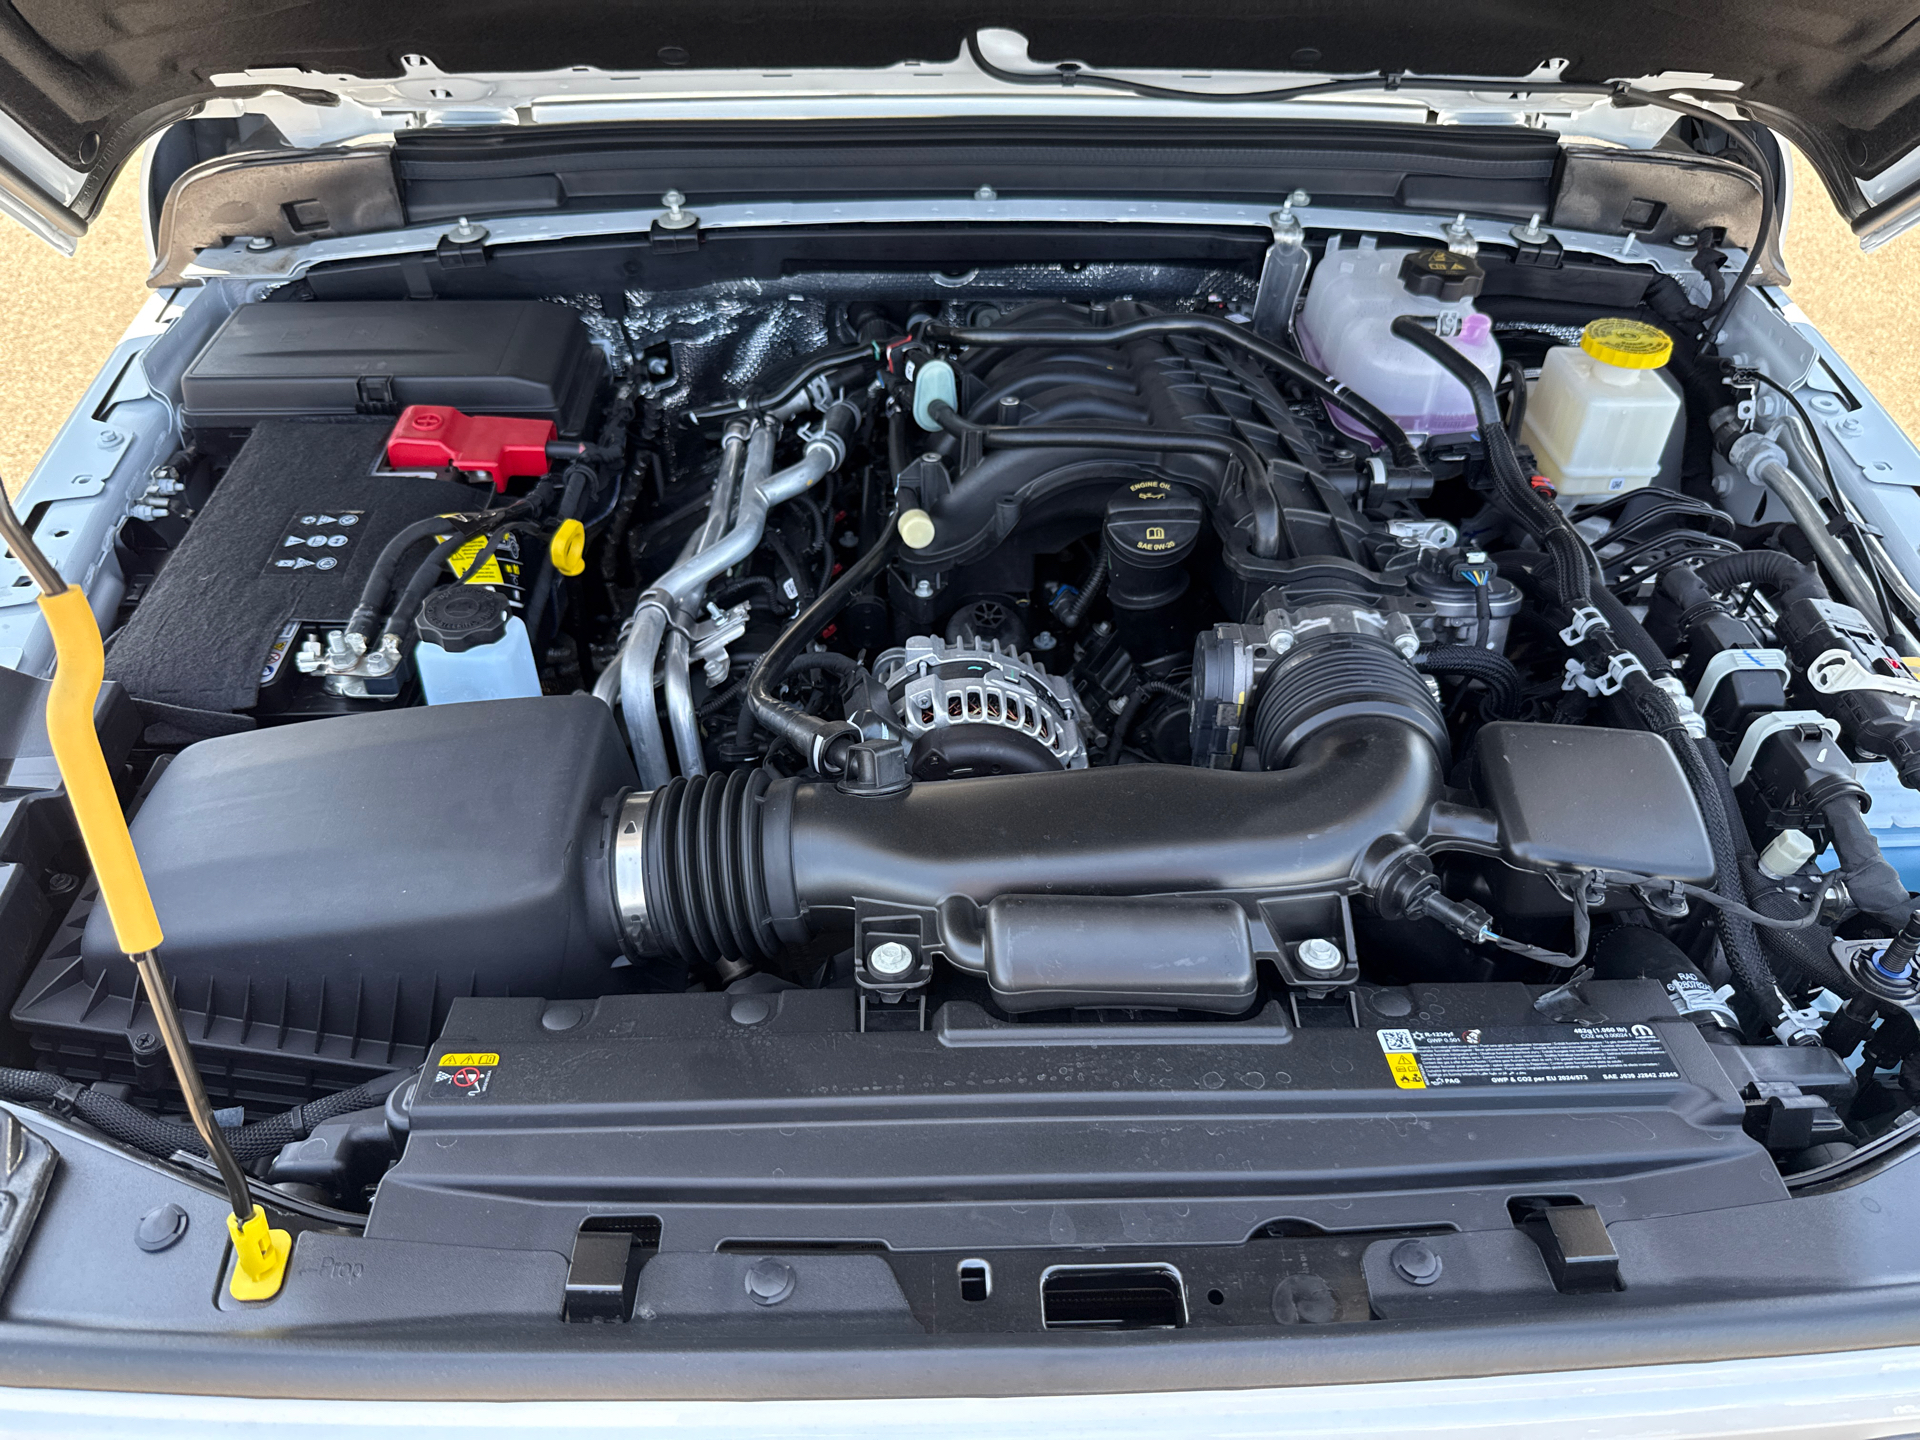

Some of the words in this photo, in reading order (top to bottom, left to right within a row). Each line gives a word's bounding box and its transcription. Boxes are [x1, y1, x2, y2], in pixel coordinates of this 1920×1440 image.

[1130, 481, 1158, 491] ENGINE
[1159, 482, 1171, 491] OIL
[1137, 541, 1153, 551] SAE
[1153, 541, 1175, 551] 0W-20
[1677, 973, 1698, 981] RAD
[320, 1256, 364, 1285] Prop
